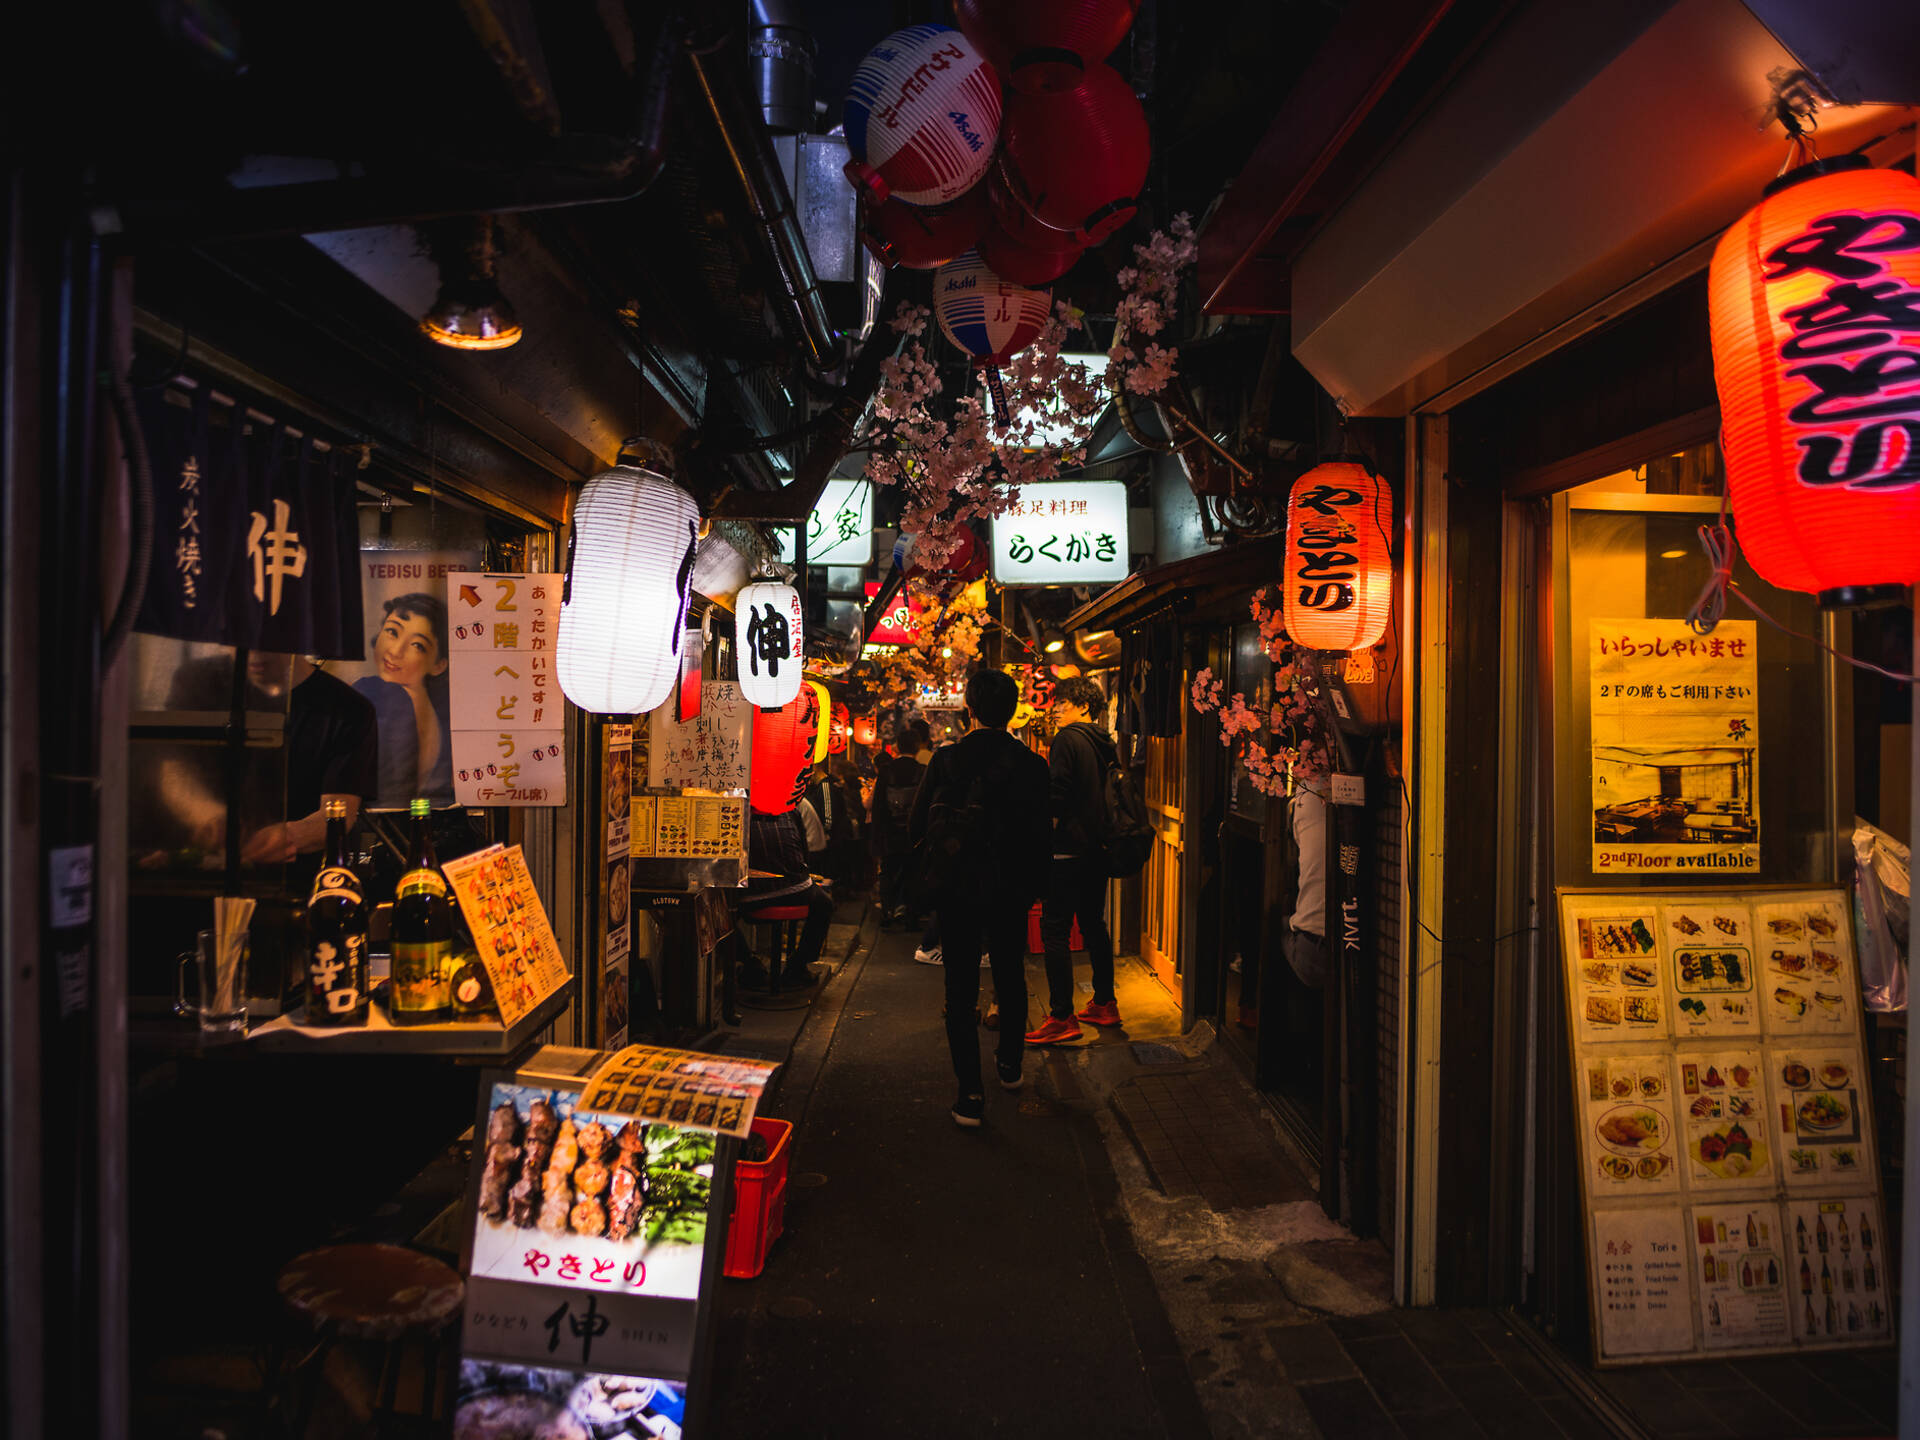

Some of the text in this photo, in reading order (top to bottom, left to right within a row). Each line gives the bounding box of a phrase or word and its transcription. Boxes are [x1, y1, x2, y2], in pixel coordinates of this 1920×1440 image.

[949, 111, 984, 152] Asahi
[944, 275, 977, 292] Asahi
[1009, 531, 1117, 563] らくがき
[1297, 484, 1364, 612] やきとり
[368, 563, 422, 579] YEBISU
[1600, 635, 1747, 658] いらっしゃいませ
[493, 579, 520, 789] 2階へどうぞ
[1676, 852, 1754, 868] available
[523, 1247, 648, 1288] やきとり
[621, 1328, 669, 1345] SHIN
